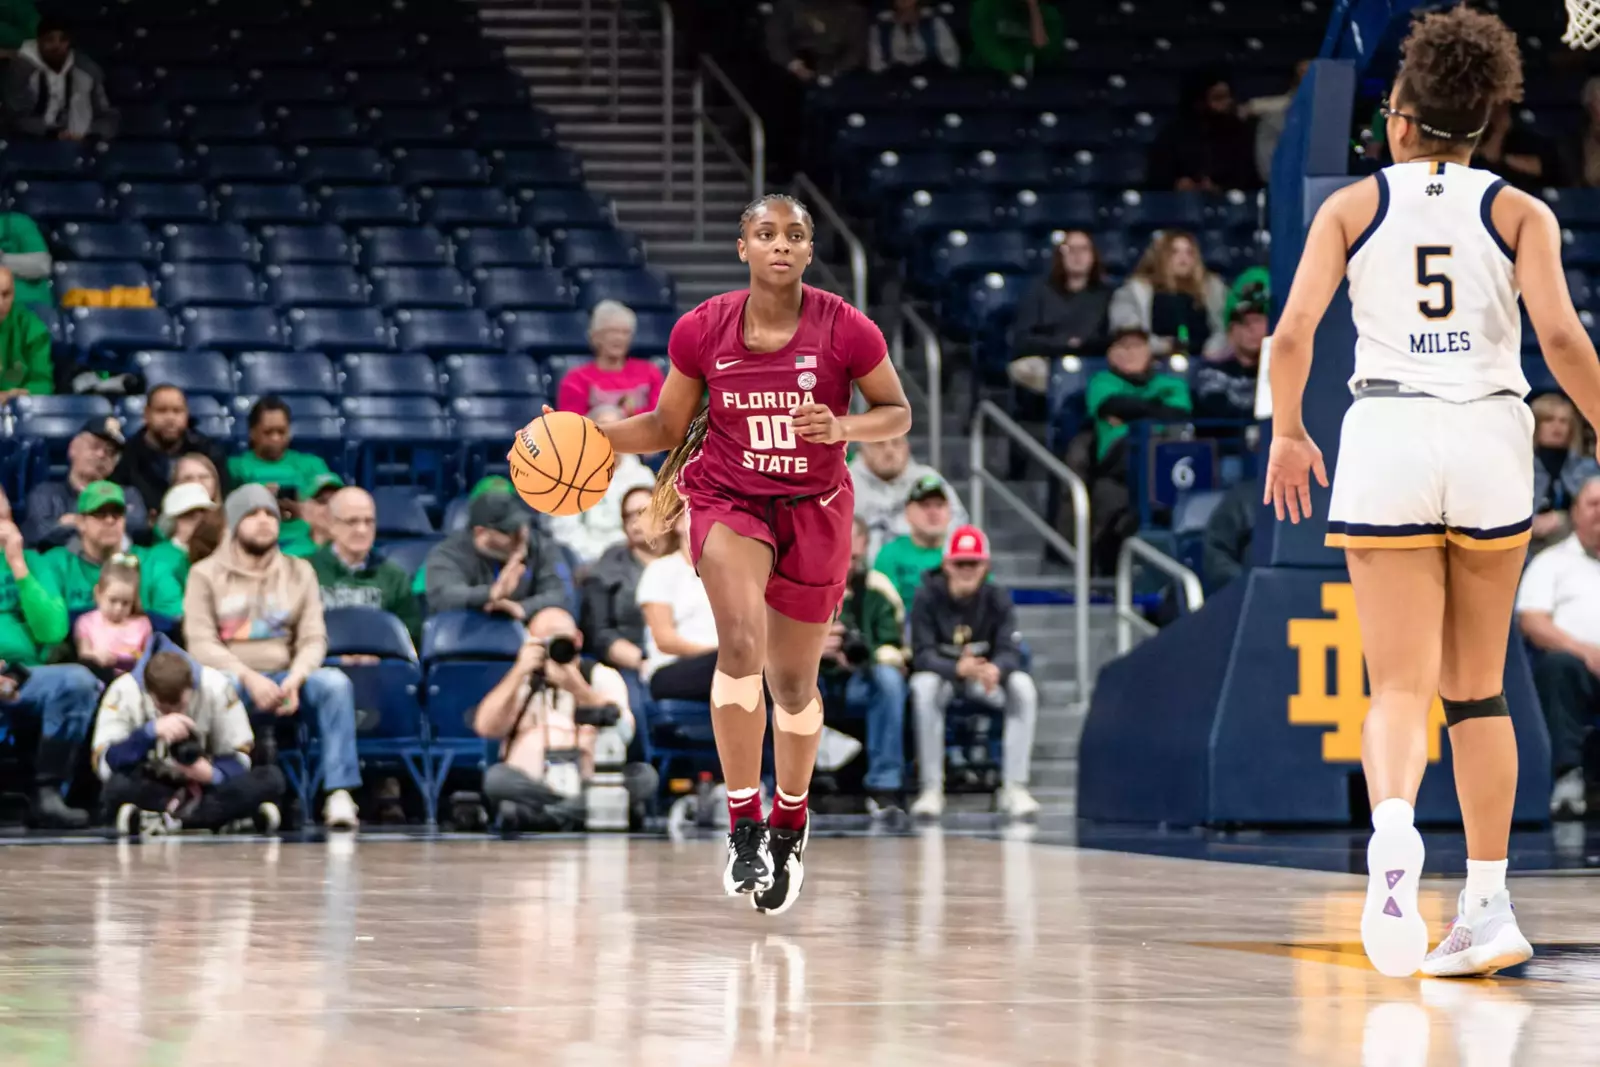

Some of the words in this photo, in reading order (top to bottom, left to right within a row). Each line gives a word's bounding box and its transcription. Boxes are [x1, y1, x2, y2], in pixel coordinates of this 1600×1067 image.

[1415, 245, 1455, 322] 5
[1409, 331, 1472, 353] MILES
[722, 391, 815, 409] FLORIDA
[746, 415, 796, 449] 00
[742, 450, 808, 474] STATE
[1171, 456, 1195, 489] 6
